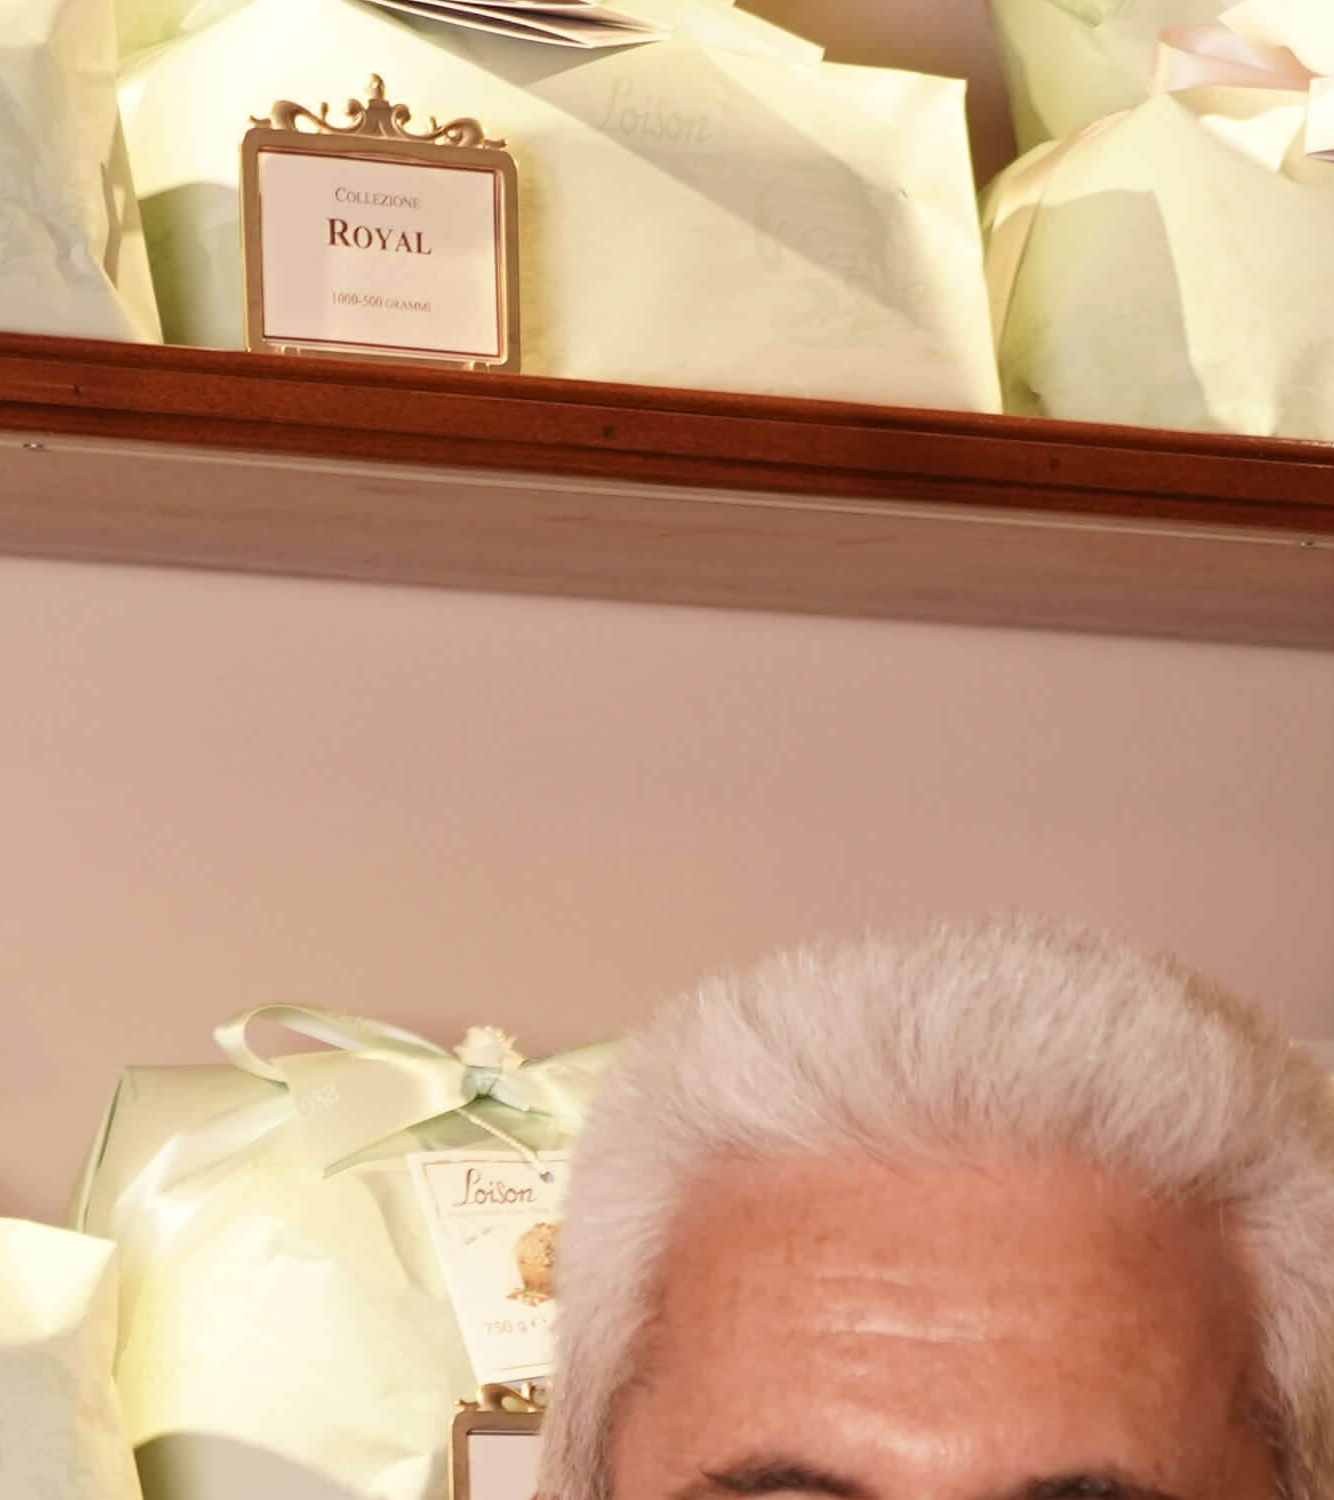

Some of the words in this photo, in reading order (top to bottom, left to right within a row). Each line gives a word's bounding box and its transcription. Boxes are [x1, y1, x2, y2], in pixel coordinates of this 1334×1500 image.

[334, 187, 420, 209] COLLEZIONE
[327, 217, 432, 255] ROYAL
[332, 292, 383, 308] 1000-500
[452, 1168, 537, 1207] Loison
